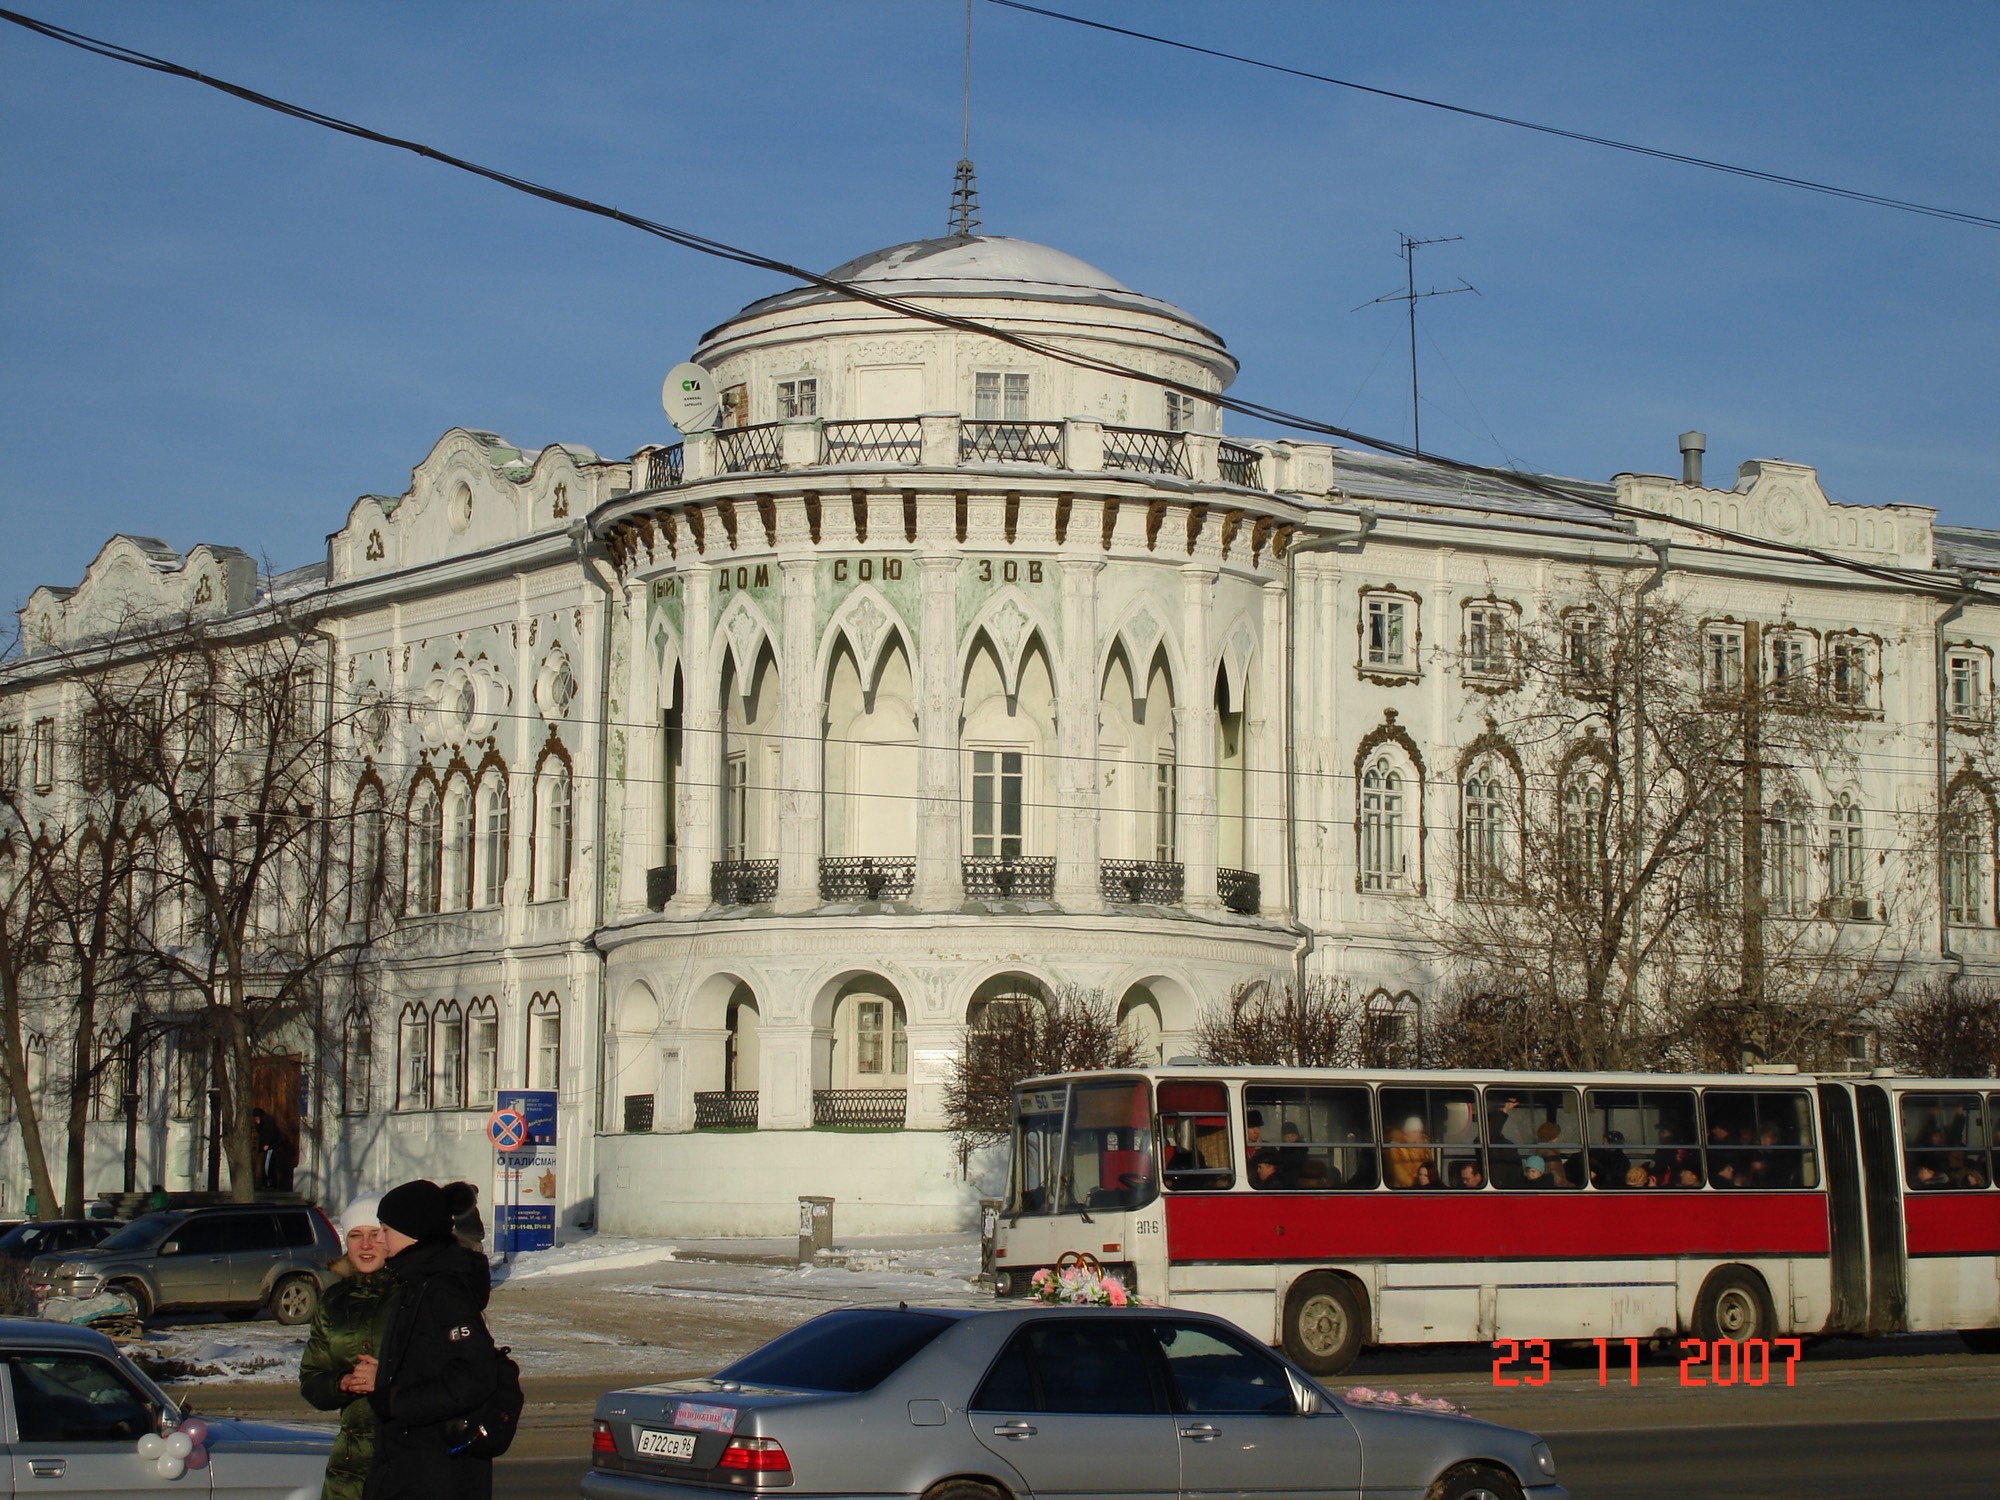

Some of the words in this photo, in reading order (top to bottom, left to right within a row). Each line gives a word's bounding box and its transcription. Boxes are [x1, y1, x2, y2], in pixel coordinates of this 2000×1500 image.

[719, 564, 769, 592] ДОМ
[1034, 1094, 1049, 1109] 50
[508, 1157, 557, 1166] ТАЛИСМАН
